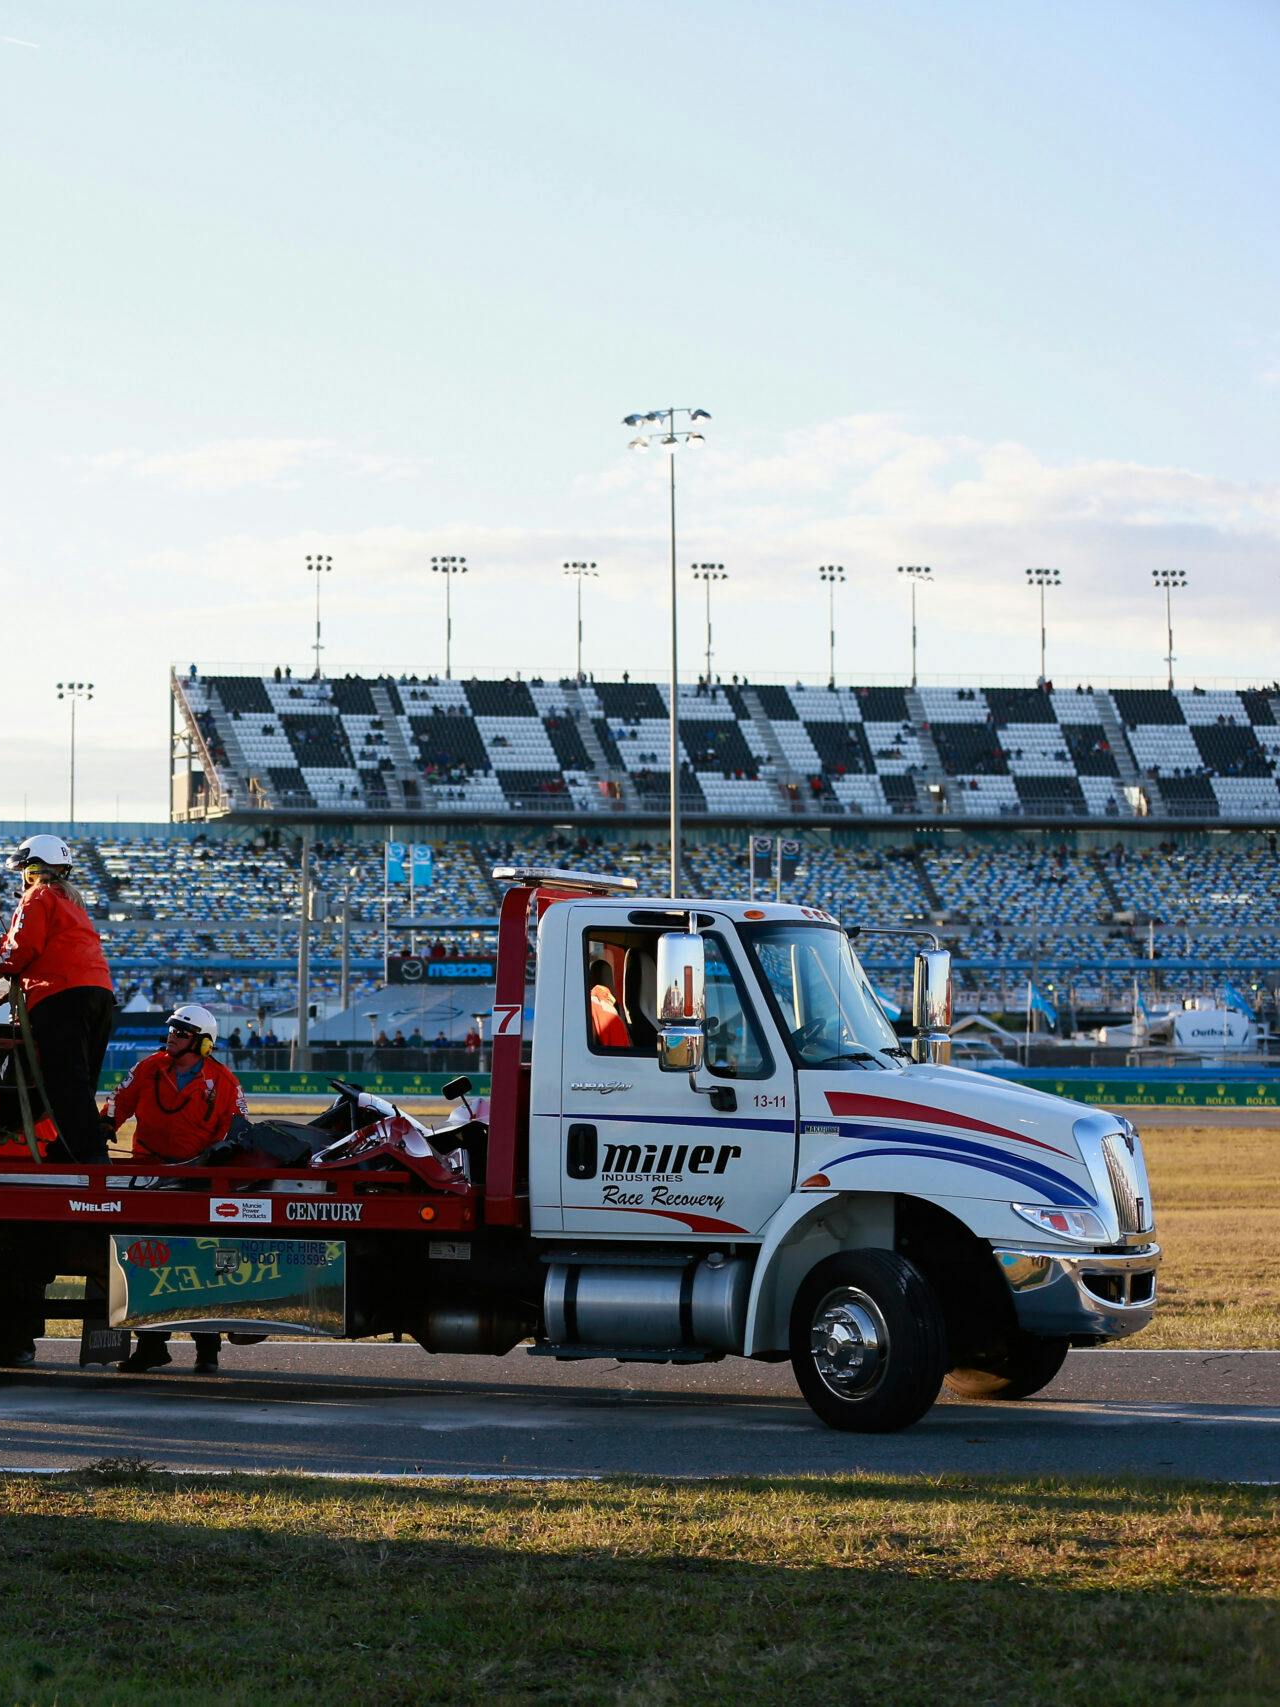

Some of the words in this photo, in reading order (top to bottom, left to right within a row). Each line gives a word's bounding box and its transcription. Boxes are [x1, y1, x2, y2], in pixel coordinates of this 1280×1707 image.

[494, 1006, 521, 1034] 7
[403, 1086, 432, 1094] ROLEX
[753, 1095, 786, 1108] 13-11
[1246, 1097, 1277, 1105] ROLEX
[602, 1174, 683, 1182] INDUSTRIES
[602, 1185, 644, 1205] Race
[651, 1185, 725, 1210] Recovery
[69, 1201, 121, 1212] WHELEN
[285, 1202, 363, 1222] CENTURY
[128, 1240, 171, 1268] AAA
[241, 1241, 266, 1252] NOT
[272, 1242, 293, 1252] FOR
[298, 1242, 326, 1254] HIRE
[241, 1252, 281, 1264] USDOT
